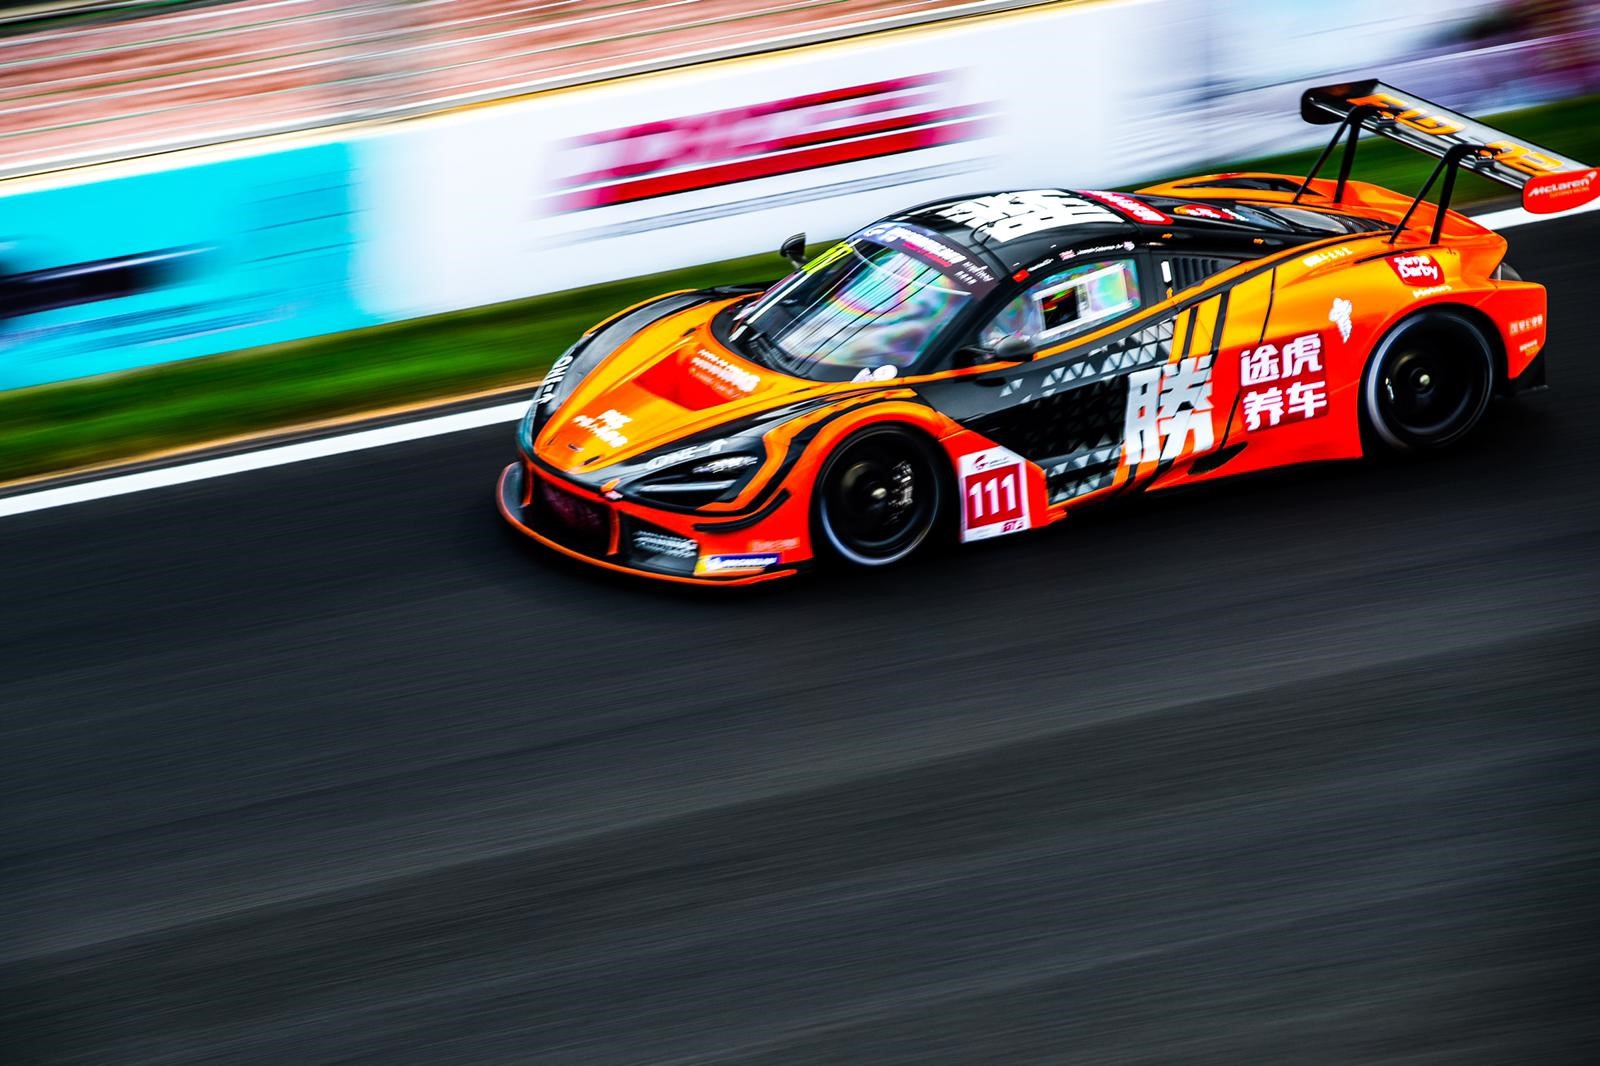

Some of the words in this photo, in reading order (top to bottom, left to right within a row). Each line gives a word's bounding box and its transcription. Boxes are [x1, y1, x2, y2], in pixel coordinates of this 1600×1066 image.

[1528, 178, 1590, 198] McLaren
[1398, 265, 1438, 280] Darby
[1240, 333, 1323, 387] 途虎
[1123, 354, 1215, 465] 勝
[1242, 380, 1328, 431] 养车
[968, 473, 1017, 519] 111
